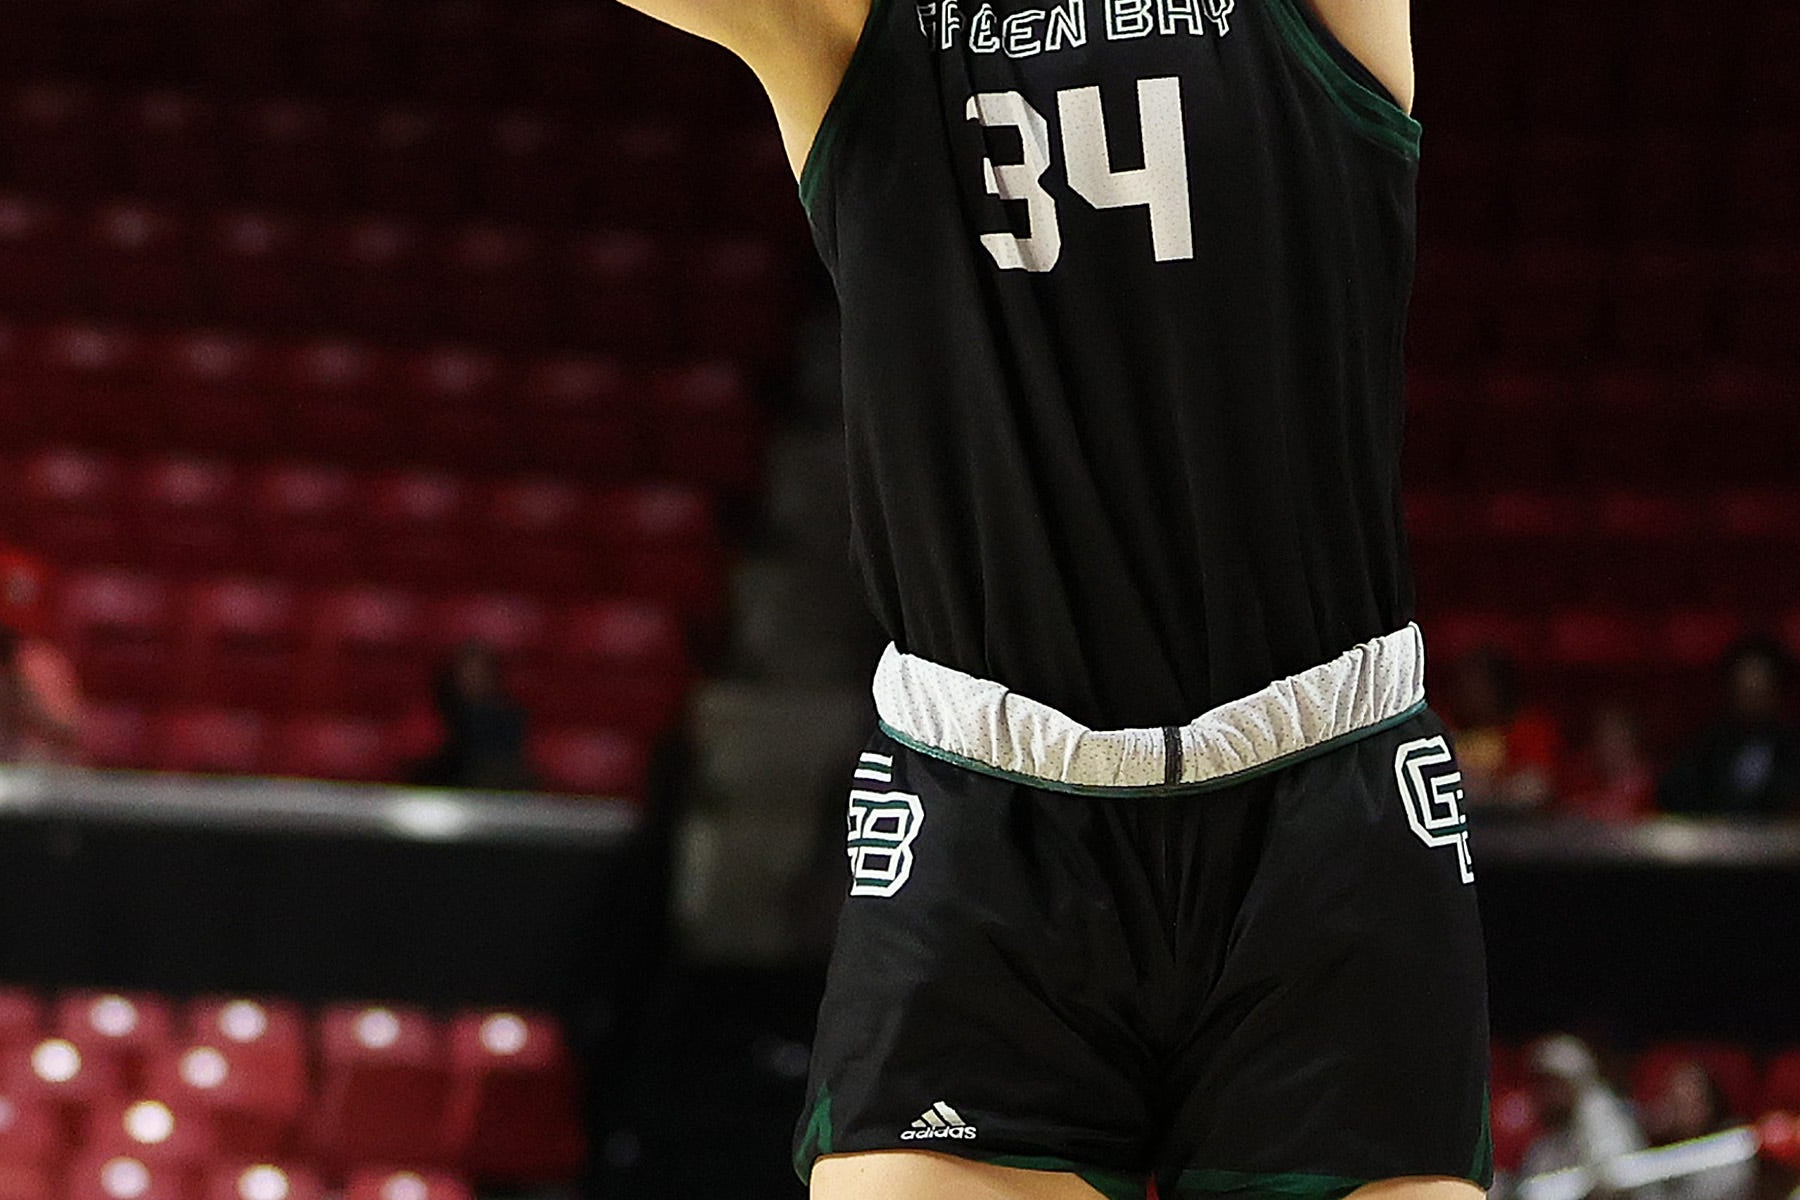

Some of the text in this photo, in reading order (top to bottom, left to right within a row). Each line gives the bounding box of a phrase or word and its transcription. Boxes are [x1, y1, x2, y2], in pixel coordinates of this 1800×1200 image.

[966, 76, 1194, 272] 34
[847, 752, 925, 897] B
[1394, 735, 1475, 884] G
[900, 1126, 977, 1140] adidas
